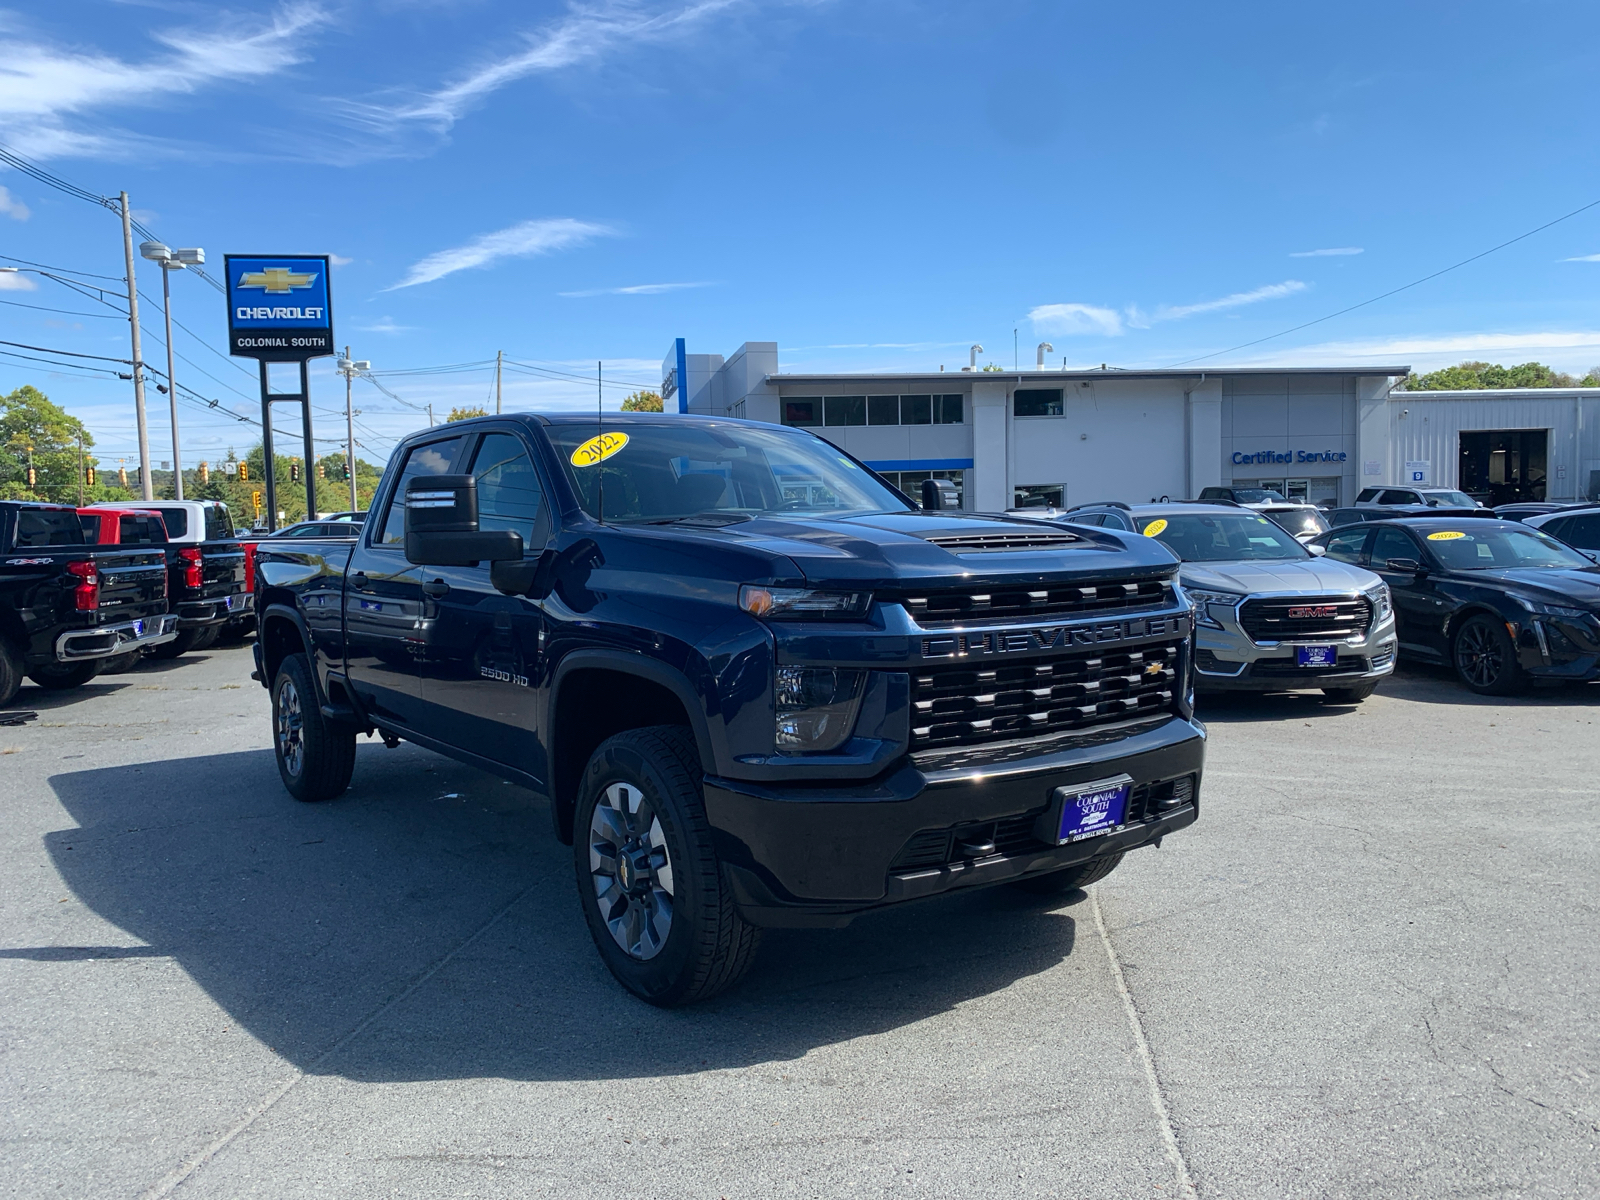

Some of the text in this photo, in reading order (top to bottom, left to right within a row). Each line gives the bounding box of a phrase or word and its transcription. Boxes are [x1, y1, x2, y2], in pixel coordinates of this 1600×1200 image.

[237, 307, 323, 319] CHEVROLET
[237, 337, 325, 347] COLONIAL SOUTH
[581, 435, 620, 462] 2022
[1232, 450, 1347, 465] Certified Service
[1415, 472, 1421, 480] 9
[1147, 521, 1164, 535] 2023
[1288, 606, 1338, 618] GMC
[921, 617, 1185, 659] CHEVROLET
[481, 666, 528, 687] 2500 HD
[1076, 791, 1117, 807] COLONIAL
[1081, 801, 1110, 815] SOUTH
[1083, 813, 1105, 822] CHEVROLET
